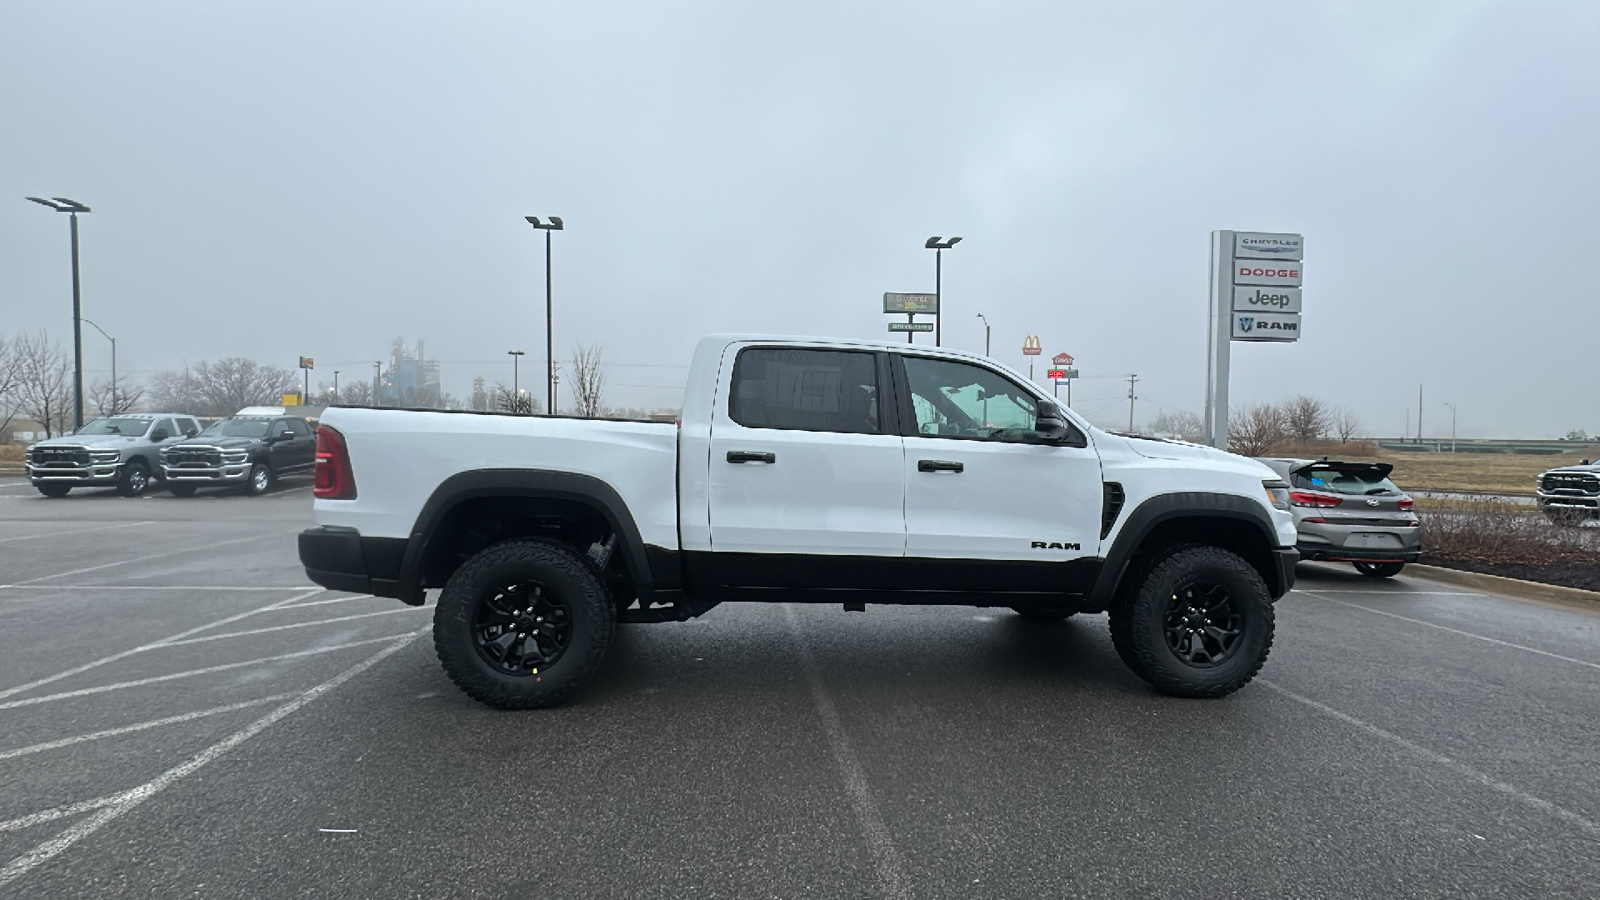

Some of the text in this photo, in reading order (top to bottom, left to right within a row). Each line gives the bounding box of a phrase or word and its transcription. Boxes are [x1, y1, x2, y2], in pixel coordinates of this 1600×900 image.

[1243, 238, 1298, 246] CHRYSLER
[1240, 268, 1299, 277] DODGE
[1248, 290, 1290, 308] Jeep
[1256, 321, 1297, 330] RAM
[1031, 541, 1081, 550] RAM
